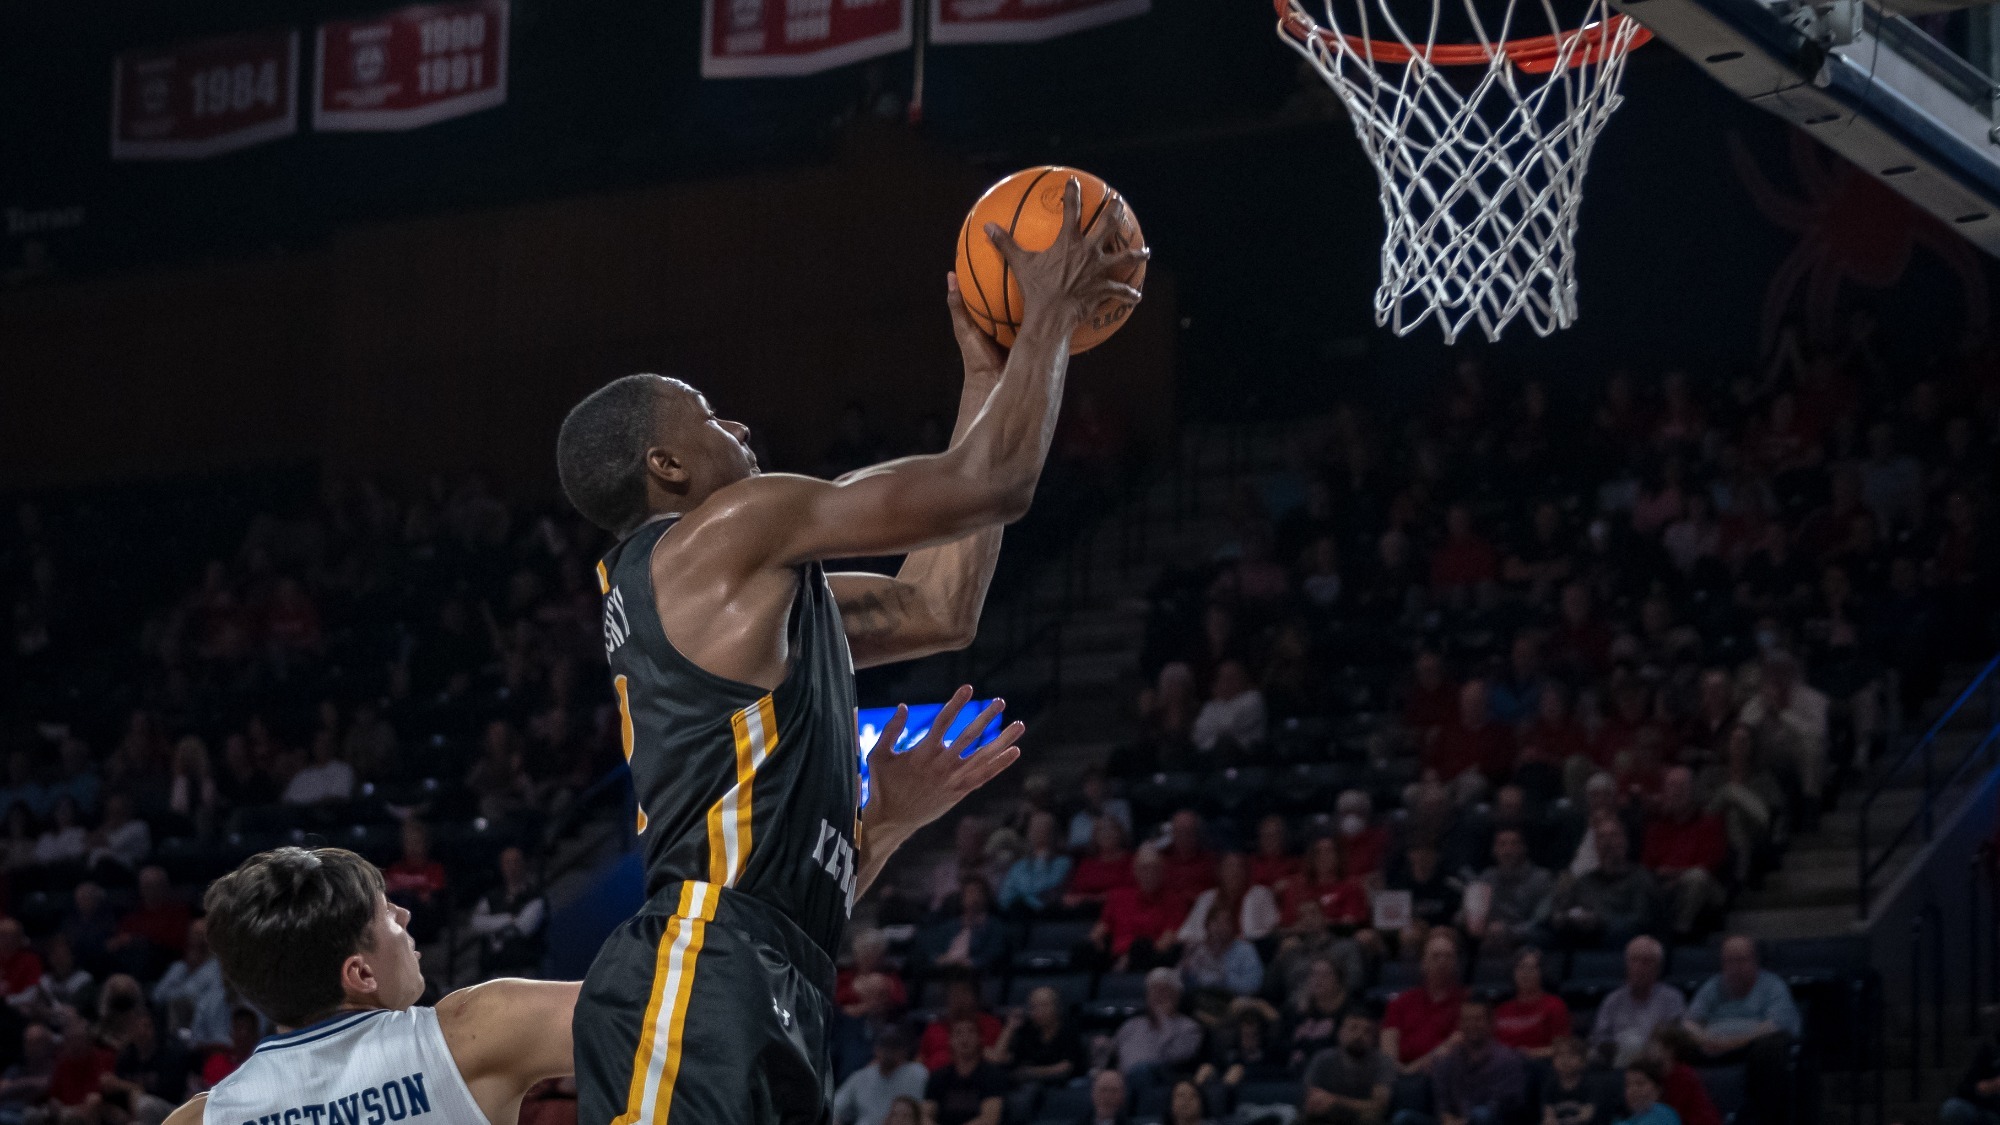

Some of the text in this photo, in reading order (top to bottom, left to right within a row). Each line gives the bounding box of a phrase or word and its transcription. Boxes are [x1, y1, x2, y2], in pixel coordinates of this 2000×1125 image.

[191, 60, 278, 117] 1984
[418, 54, 484, 95] 1991
[242, 1072, 432, 1125] TAVSON
